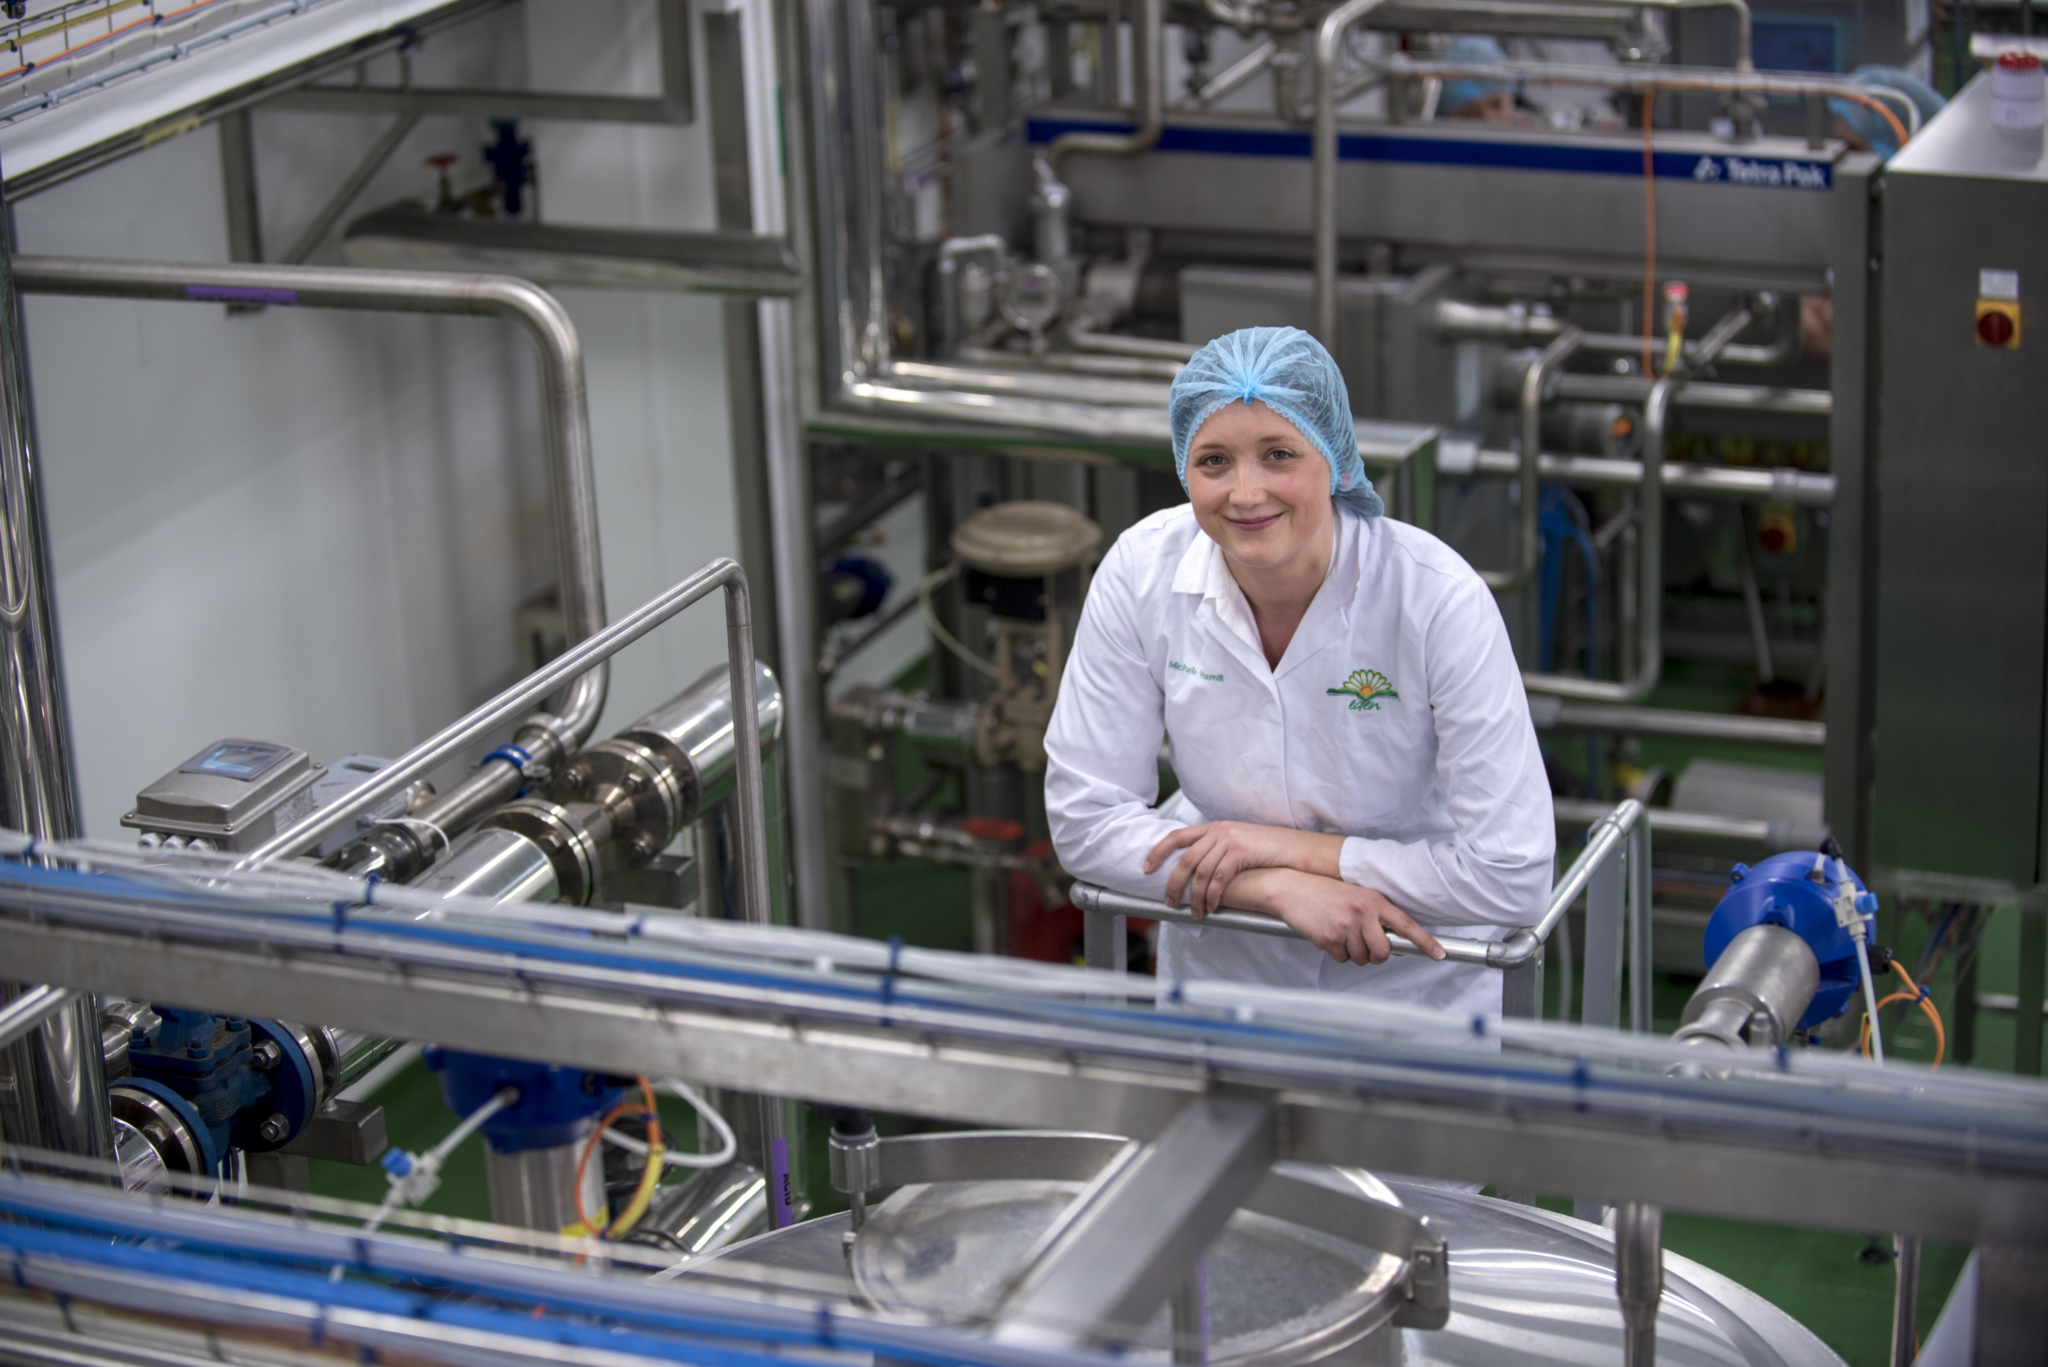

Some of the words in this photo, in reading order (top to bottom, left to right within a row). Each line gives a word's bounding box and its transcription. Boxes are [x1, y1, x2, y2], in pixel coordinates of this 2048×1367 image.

[1727, 158, 1782, 186] Tetra
[1783, 161, 1826, 189] Pak
[1348, 699, 1382, 712] eden
